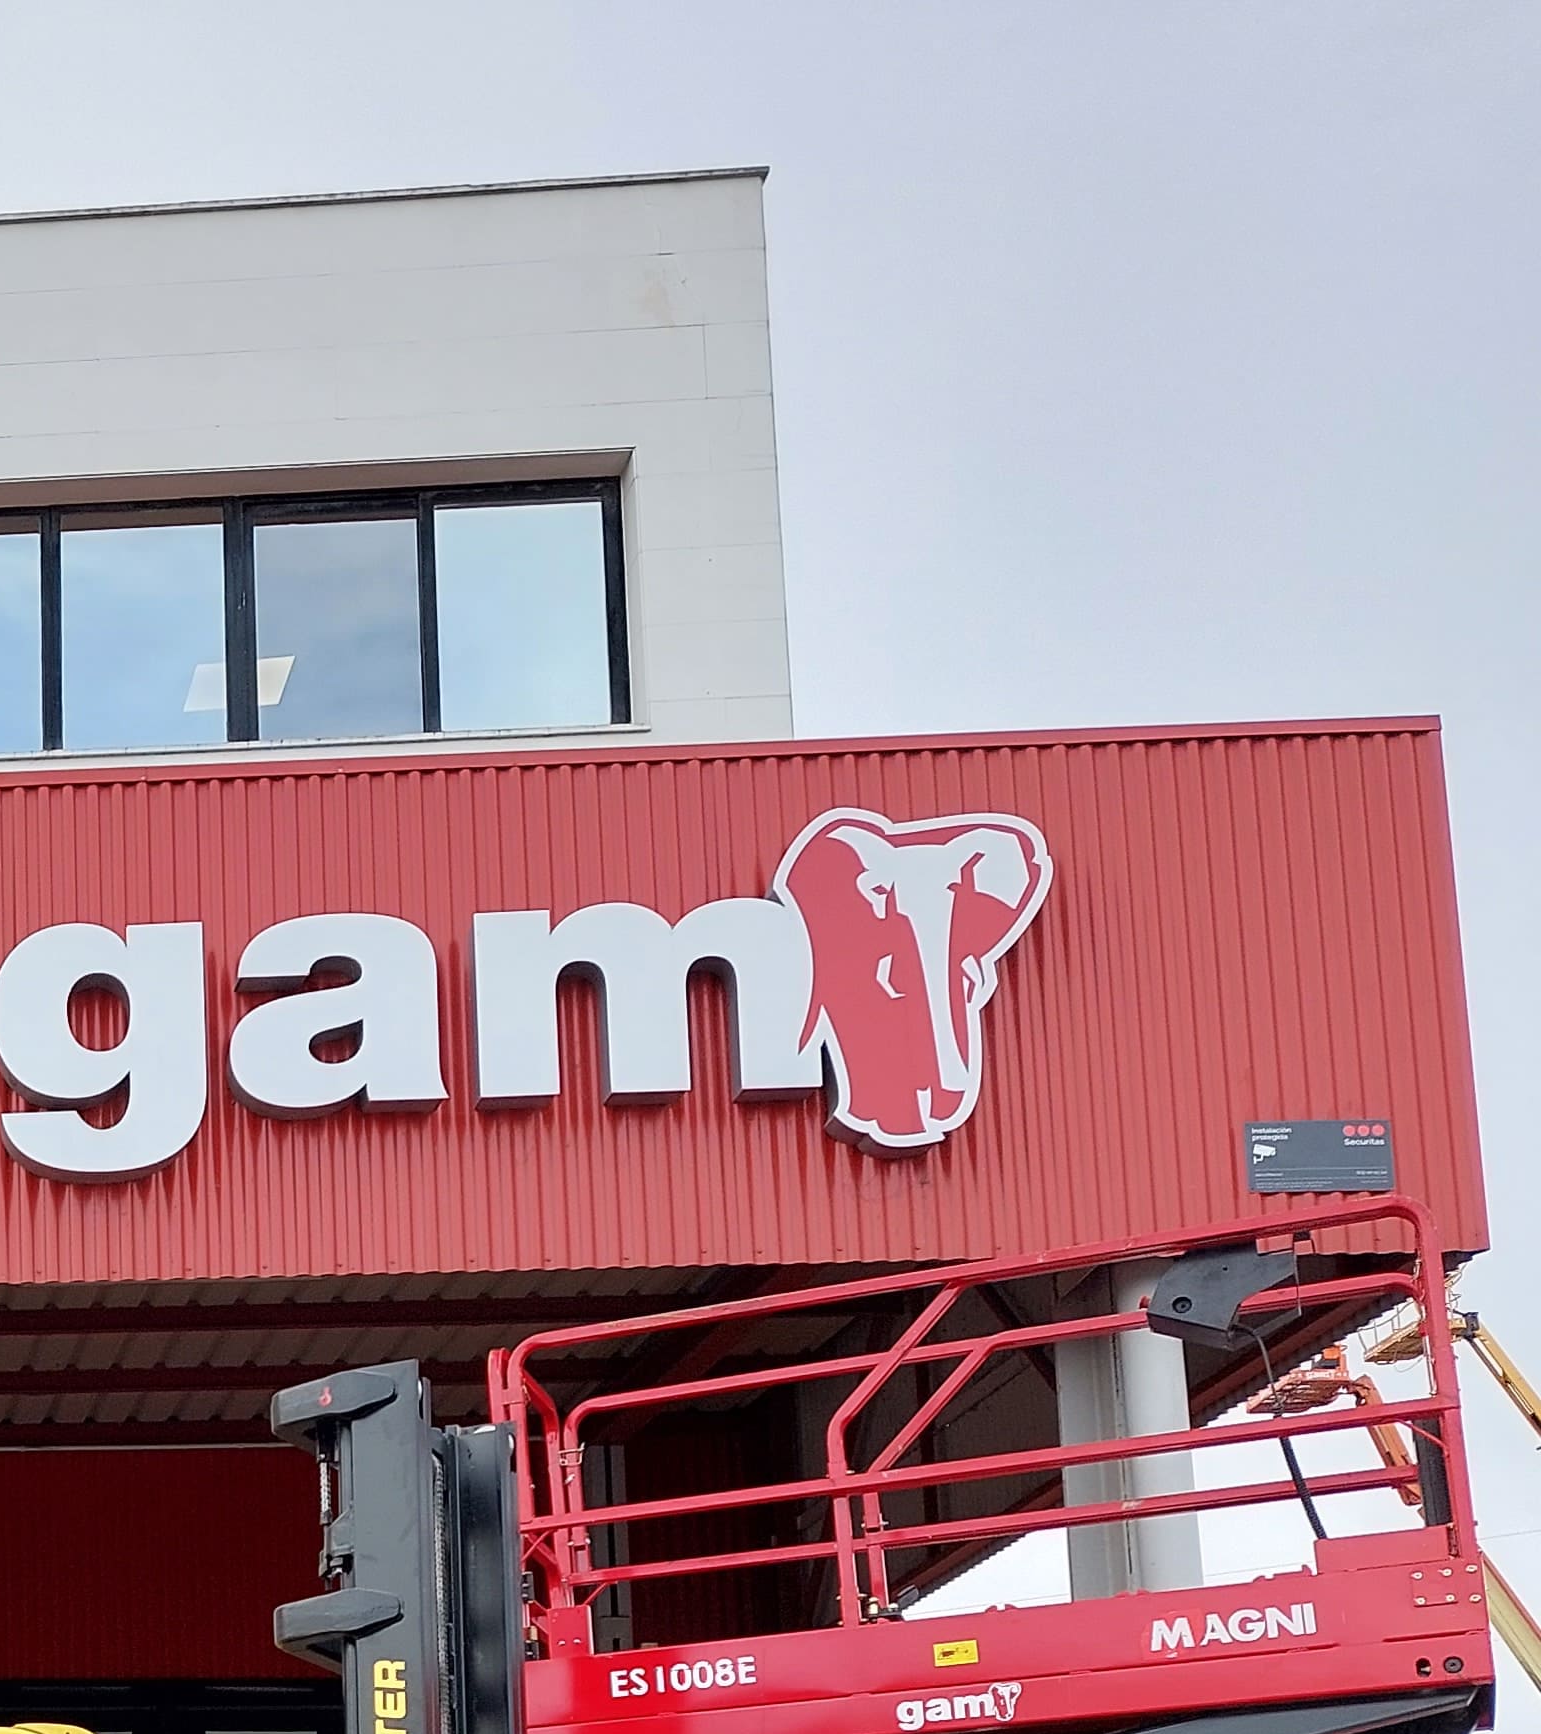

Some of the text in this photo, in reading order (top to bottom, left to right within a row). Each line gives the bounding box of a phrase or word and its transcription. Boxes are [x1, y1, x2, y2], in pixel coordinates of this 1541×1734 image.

[1343, 1138, 1385, 1146] Securitas
[1151, 1602, 1316, 1651] MAGNI
[610, 1655, 757, 1698] ES1008E
[895, 1694, 995, 1731] gam
